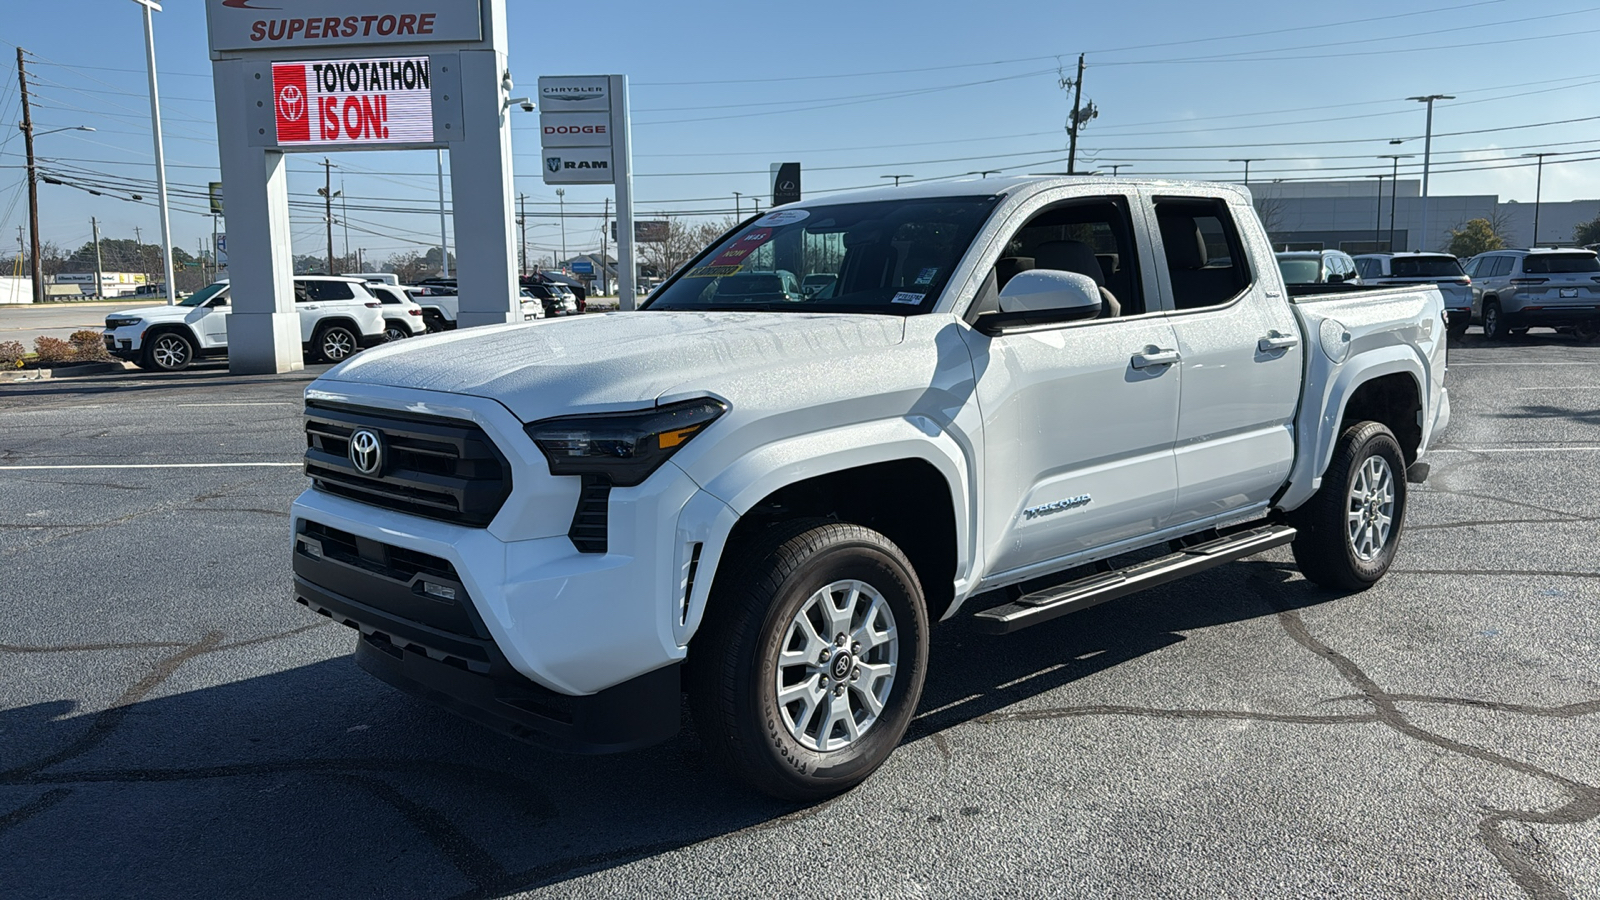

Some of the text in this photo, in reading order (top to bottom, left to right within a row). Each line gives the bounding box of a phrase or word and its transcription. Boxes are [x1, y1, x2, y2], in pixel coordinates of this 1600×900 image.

[250, 13, 437, 42] SUPERSTORE
[313, 60, 430, 92] TOYOTATHON
[318, 94, 389, 140] IS ON!
[544, 125, 606, 134] DODGE
[563, 161, 608, 169] RAM
[744, 233, 767, 241] WAS
[722, 249, 747, 257] NOW
[763, 692, 808, 776] Firestone
